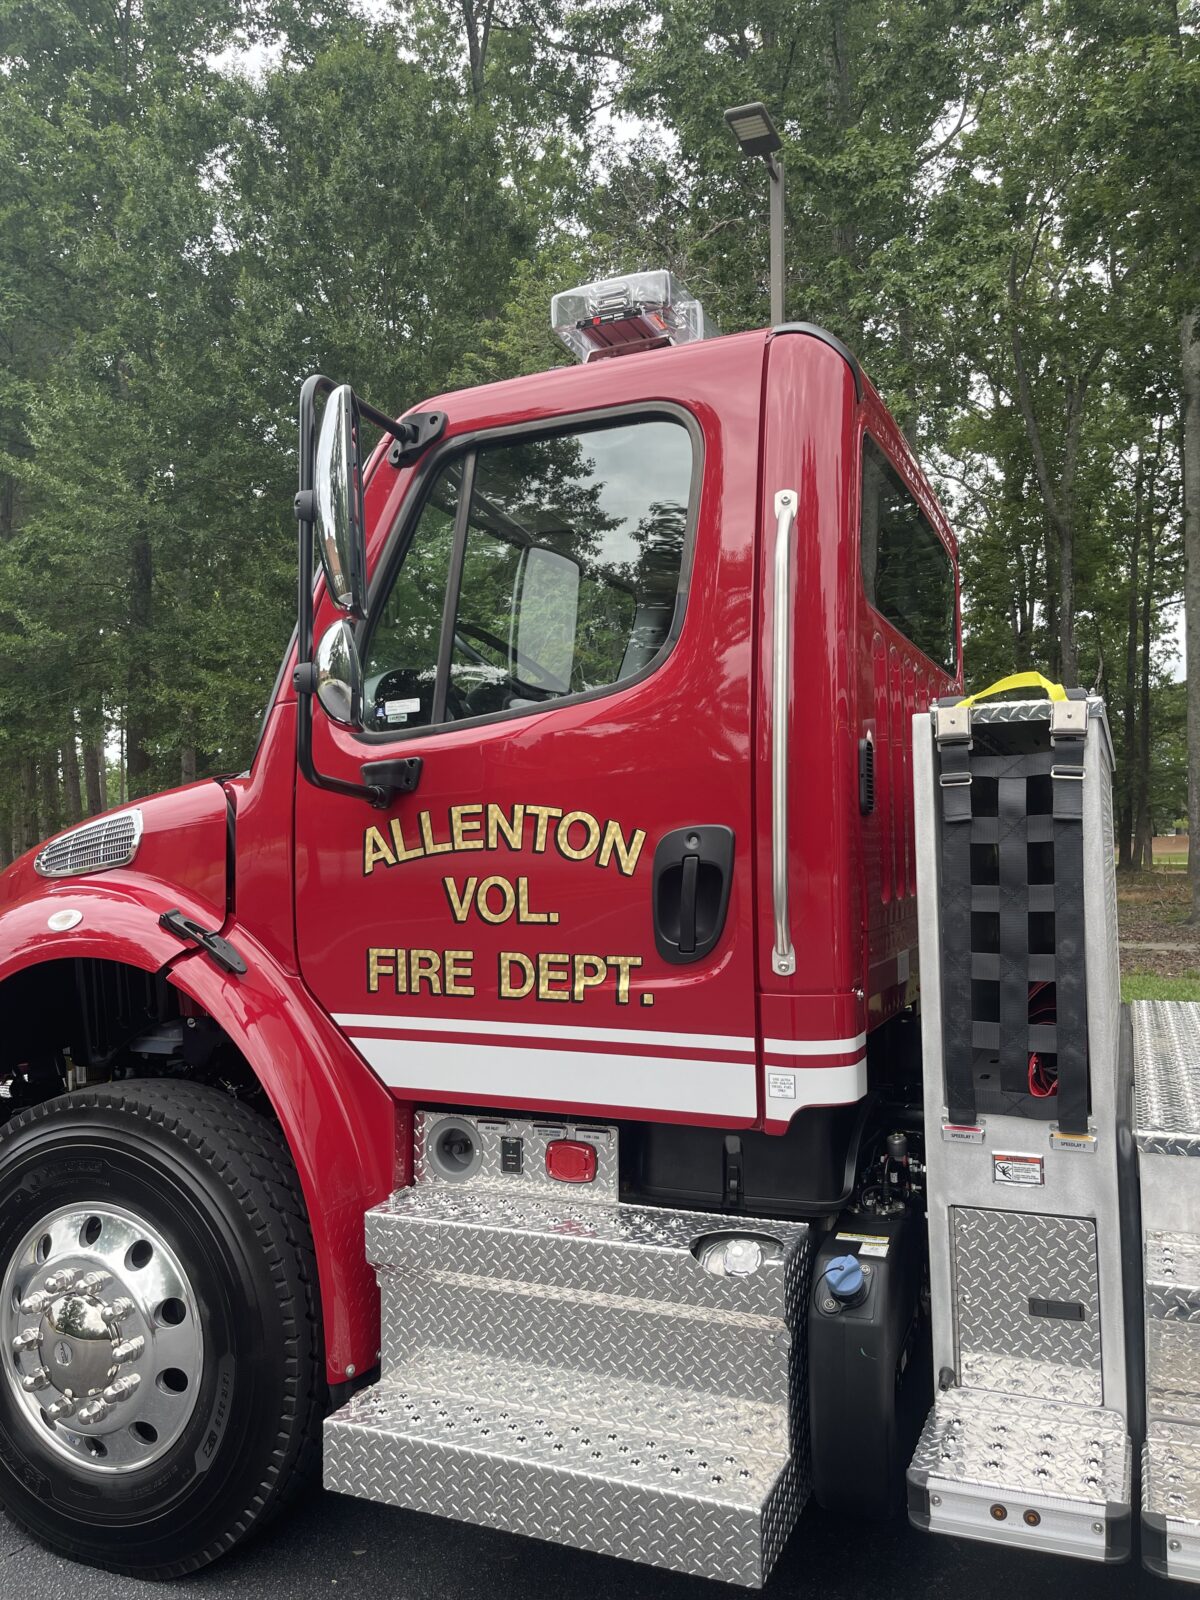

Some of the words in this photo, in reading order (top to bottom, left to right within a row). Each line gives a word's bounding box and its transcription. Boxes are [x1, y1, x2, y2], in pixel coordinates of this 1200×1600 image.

[363, 803, 646, 876] ALLENTON
[443, 875, 560, 925] VOL.
[367, 947, 475, 996] FIRE
[498, 951, 655, 1006] DEPT.
